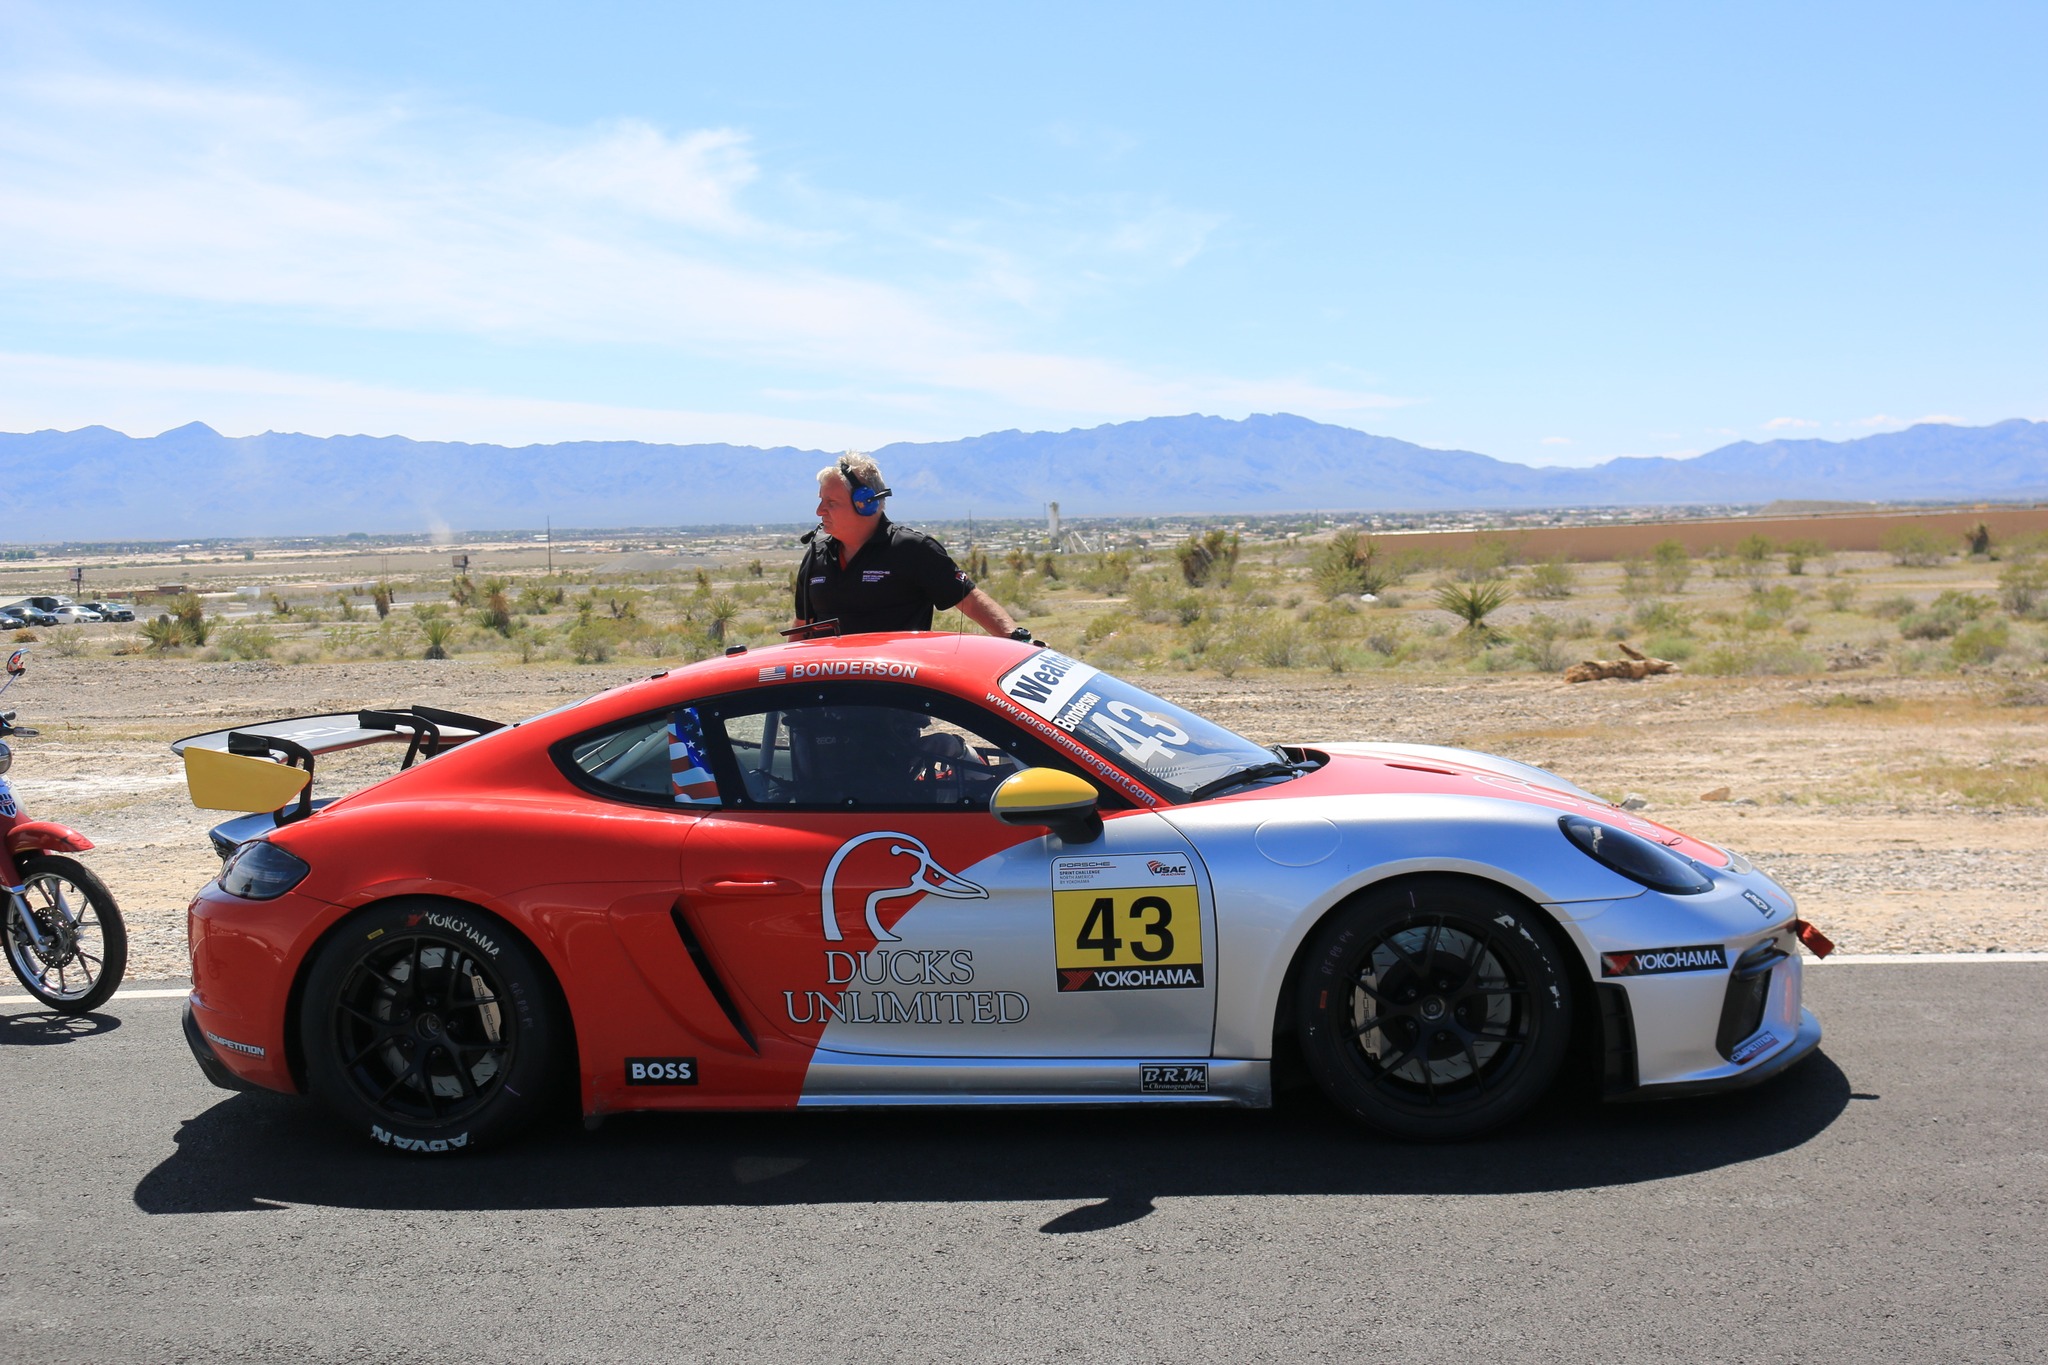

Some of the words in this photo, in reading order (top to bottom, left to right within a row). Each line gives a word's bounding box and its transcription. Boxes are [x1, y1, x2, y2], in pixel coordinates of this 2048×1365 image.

[792, 661, 918, 679] BONDERSON
[1053, 691, 1101, 733] Bonderson
[1091, 700, 1190, 764] 43
[985, 691, 1157, 807] www.porschemotorsport.com
[1154, 865, 1187, 874] USAC
[1076, 895, 1175, 962] 43
[824, 950, 975, 985] DUCKS
[1634, 950, 1722, 971] YOKOHAMA
[1094, 968, 1197, 988] YOKOHAMA
[475, 977, 500, 1041] POSCHE
[783, 991, 1030, 1025] UNLIMITED
[206, 1030, 265, 1056] COMPETITION
[631, 1062, 691, 1080] BOSS
[371, 1124, 468, 1153] ADVAN
